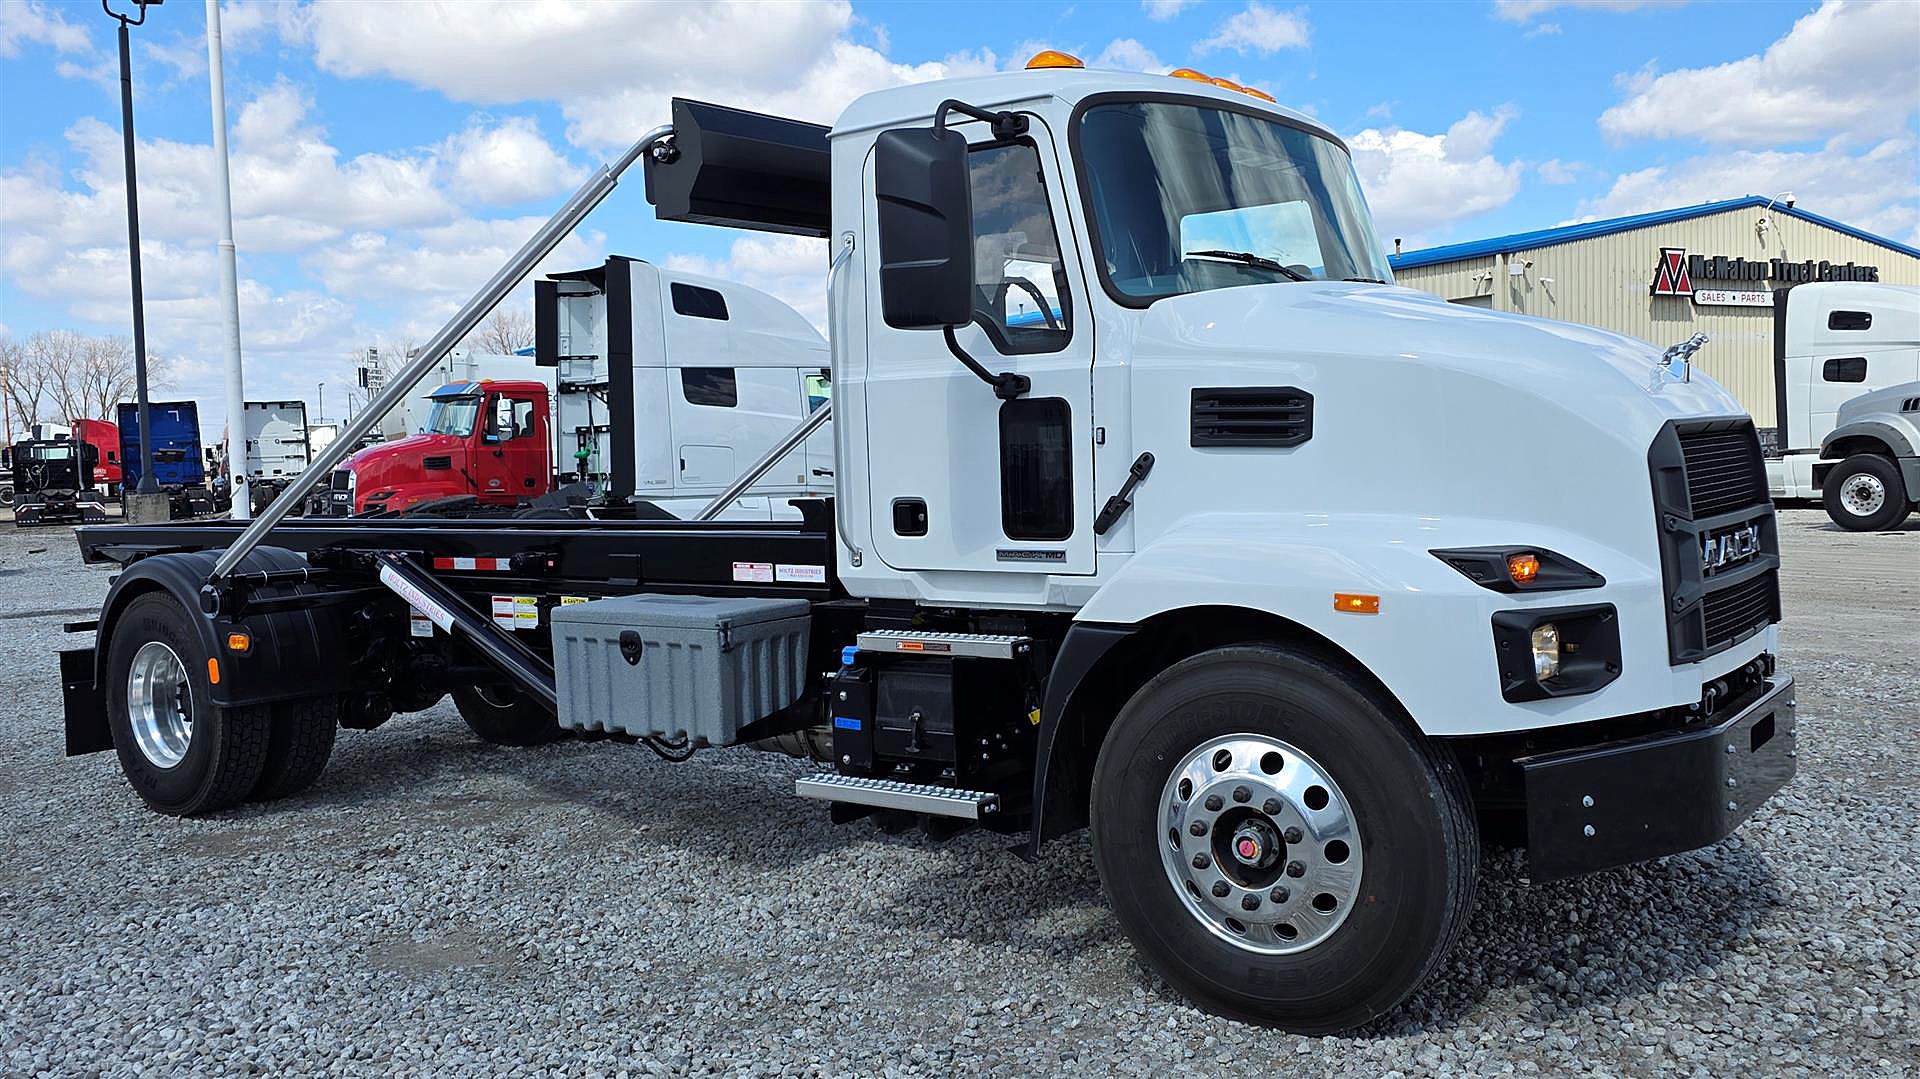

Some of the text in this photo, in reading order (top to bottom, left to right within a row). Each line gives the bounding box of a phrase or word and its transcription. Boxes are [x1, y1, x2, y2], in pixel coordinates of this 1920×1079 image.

[1689, 254, 1879, 283] McMahon Truck Centers
[1701, 292, 1766, 303] SALES PARTS
